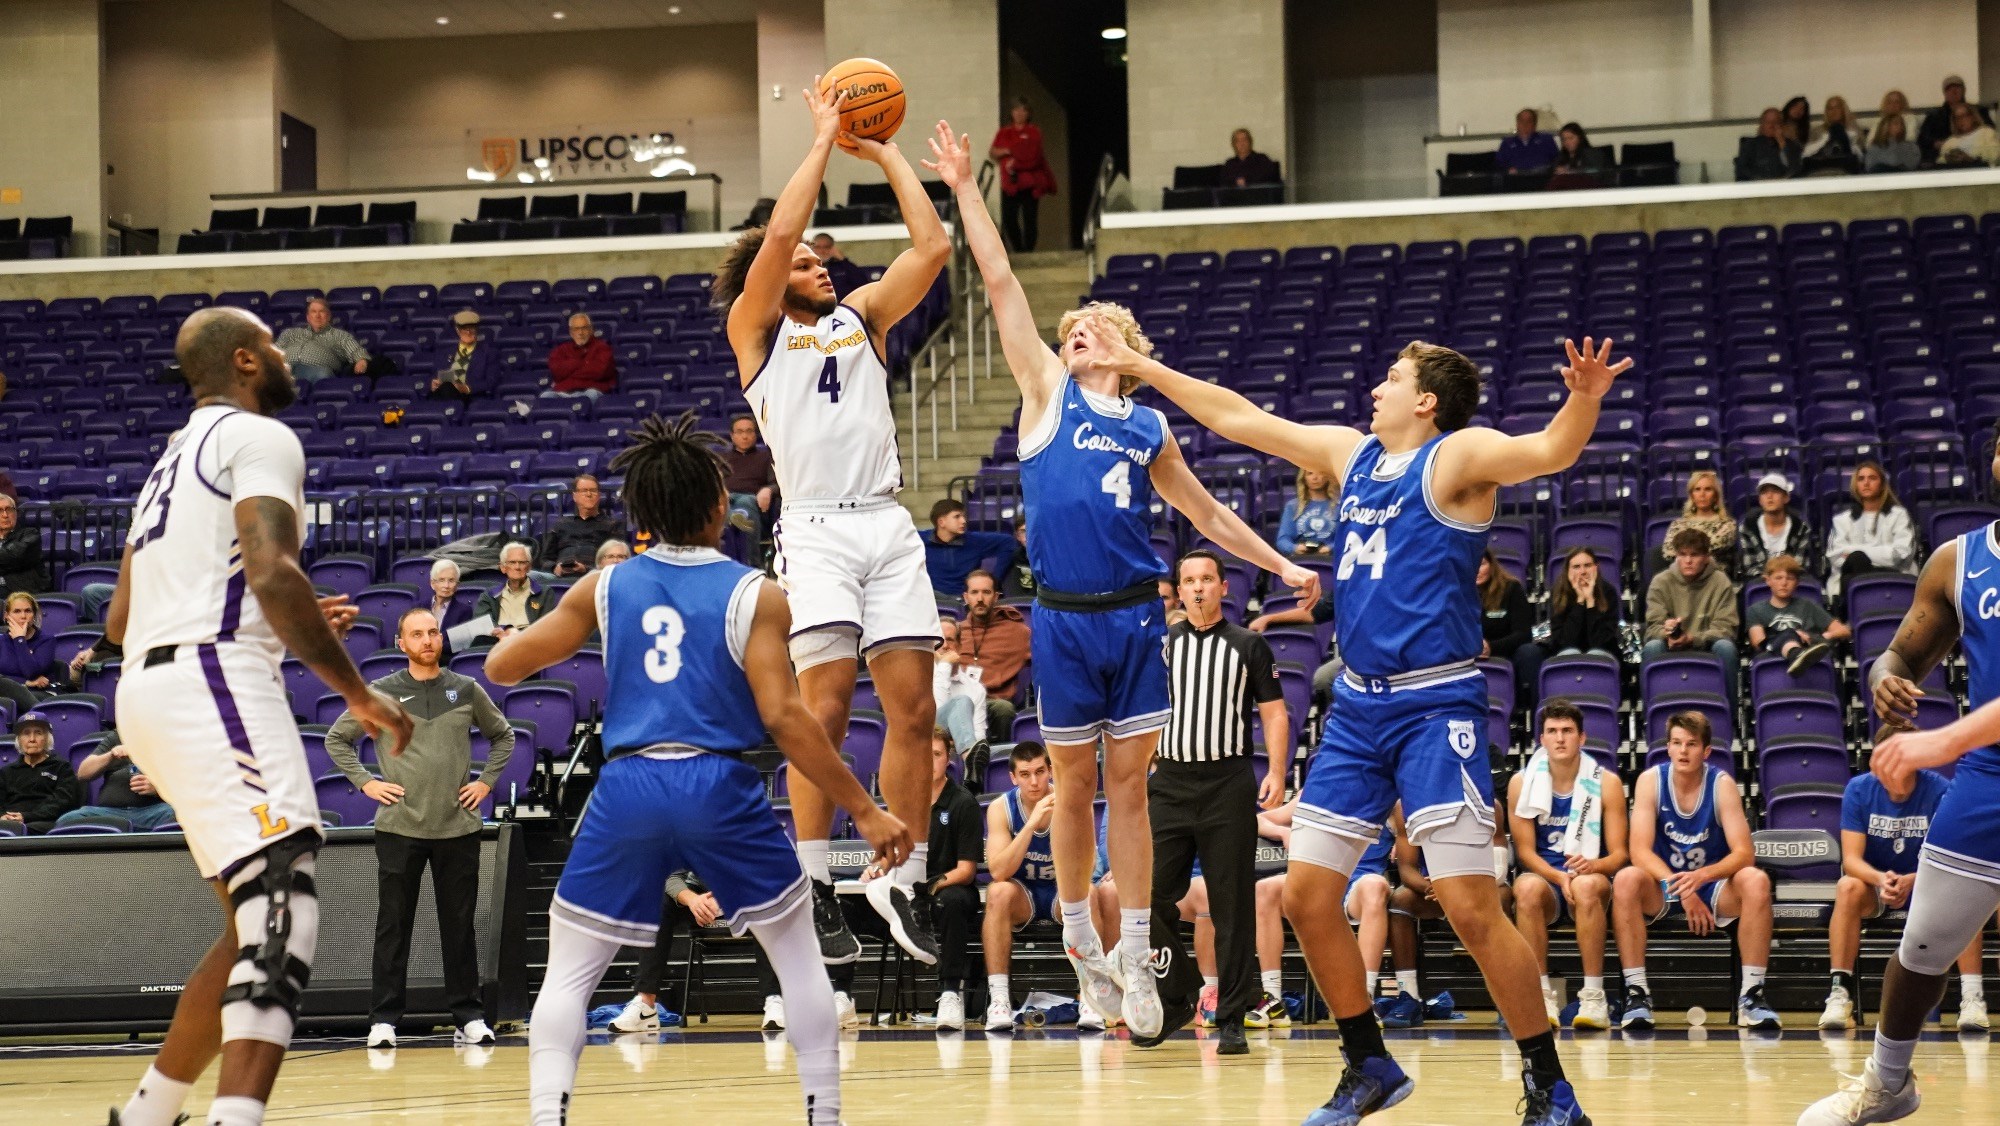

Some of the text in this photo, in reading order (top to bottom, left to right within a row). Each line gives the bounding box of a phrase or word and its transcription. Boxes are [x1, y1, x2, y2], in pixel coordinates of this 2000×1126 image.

[519, 132, 675, 162] LIPSCO
[787, 329, 867, 355] LIPOMB
[818, 356, 841, 403] 4
[1073, 422, 1152, 466] Coveant
[1101, 461, 1131, 509] 4
[1336, 527, 1388, 580] 24
[642, 605, 686, 684] 3
[1458, 732, 1470, 750] C
[249, 803, 288, 839] L
[1871, 816, 1926, 830] COVENANT
[827, 851, 875, 866] BISON
[1754, 840, 1830, 858] BISONS
[1025, 863, 1056, 880] 15
[1773, 909, 1819, 918] PSCOMB
[140, 984, 186, 993] DAKTRON
